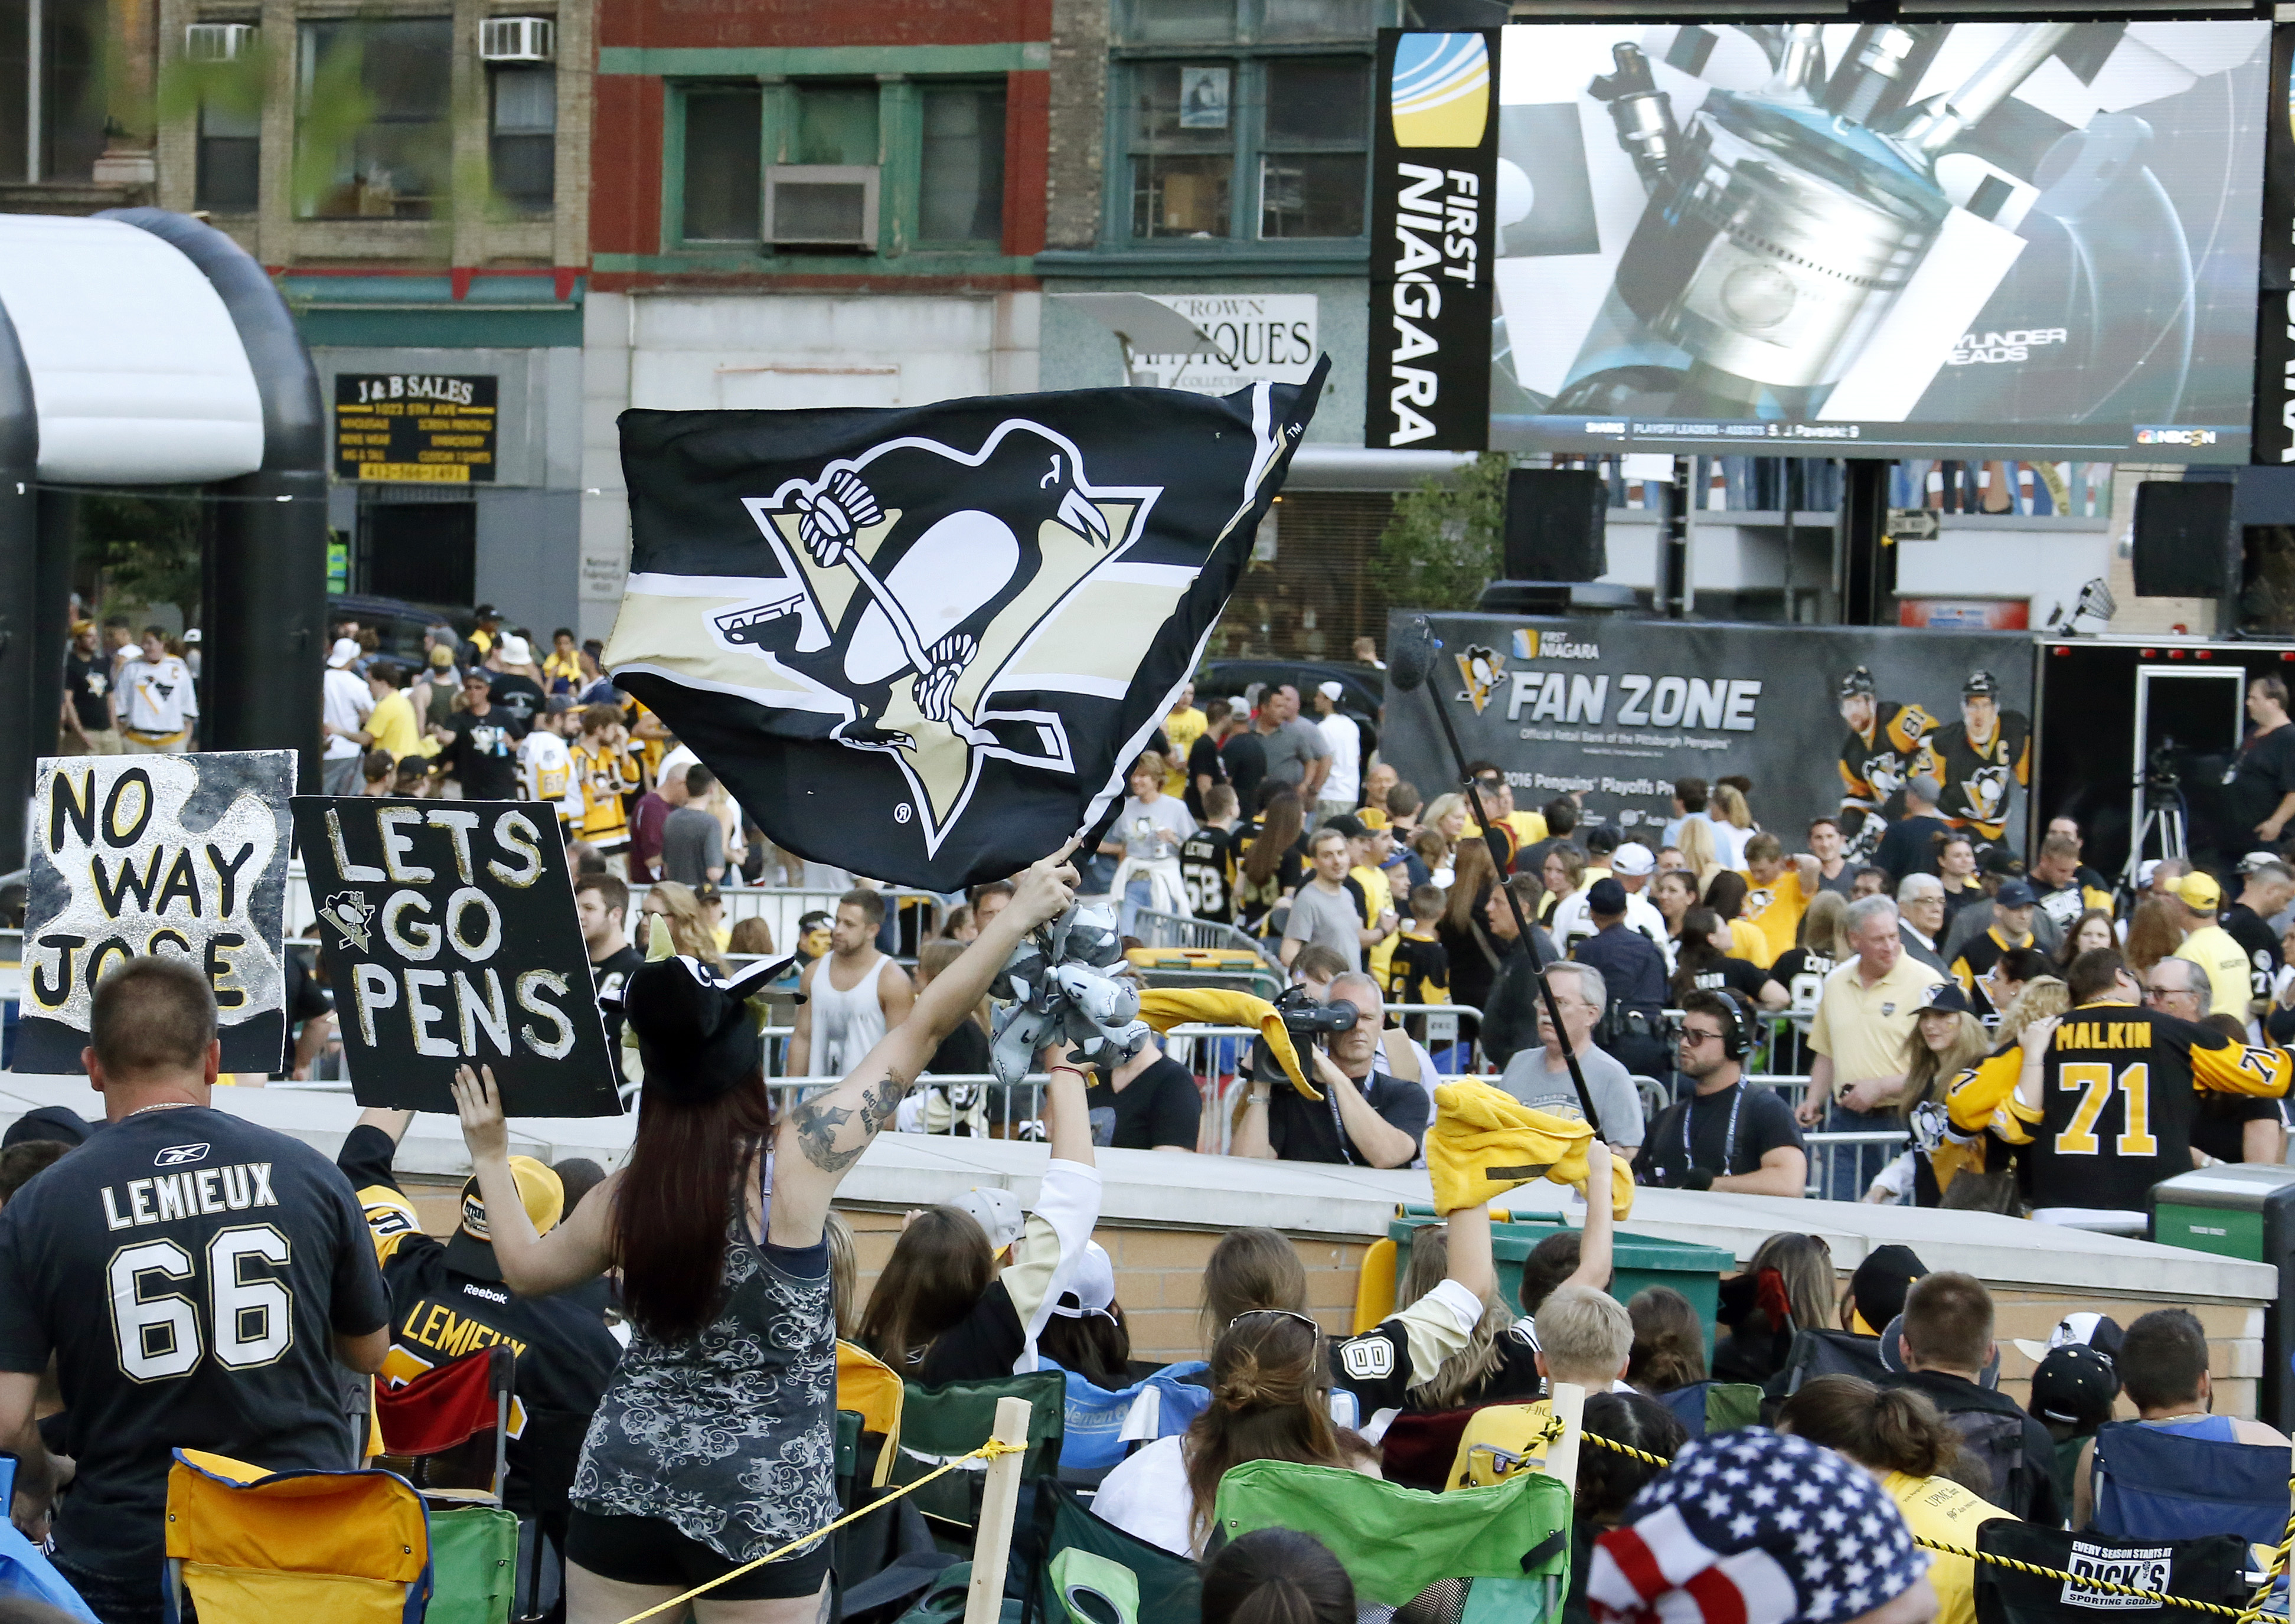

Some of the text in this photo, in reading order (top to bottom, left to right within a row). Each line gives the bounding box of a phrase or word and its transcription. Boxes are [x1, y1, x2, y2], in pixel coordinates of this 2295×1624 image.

[1444, 169, 1479, 289] FIRST
[1389, 162, 1444, 447] NIAGARA
[358, 375, 474, 405] J & B SALES
[1585, 421, 1625, 434] SHARKS
[1633, 423, 1676, 434] PLAYOFF
[1538, 642, 1600, 659] NIAGARA
[1540, 631, 1568, 642] FIRST
[1507, 671, 1762, 731] FAN ZONE
[1520, 727, 1553, 740] Official
[1581, 731, 1605, 743] Bank
[1605, 733, 1617, 743] of
[1618, 733, 1634, 745] the
[1634, 734, 1682, 749] Pittsburgh
[1997, 740, 2010, 766] C
[1601, 776, 1654, 796] Playoffs
[49, 767, 154, 854] NO
[324, 806, 547, 888] LETS
[90, 842, 254, 922] WAY
[1183, 863, 1224, 913] 58
[381, 886, 502, 962] GO
[352, 963, 576, 1061] PENS
[2056, 1022, 2152, 1051] MALKIN
[2239, 1044, 2281, 1085] 71
[2054, 1062, 2157, 1156] 71
[100, 1162, 279, 1231] LEMIEUX
[106, 1222, 294, 1384] 66
[463, 1283, 508, 1305] Reebok
[1340, 1335, 1395, 1380] 8
[2072, 1540, 2173, 1559] EVERY SEASON STARTS AT
[2069, 1594, 2158, 1606] SPORTING GOODS
